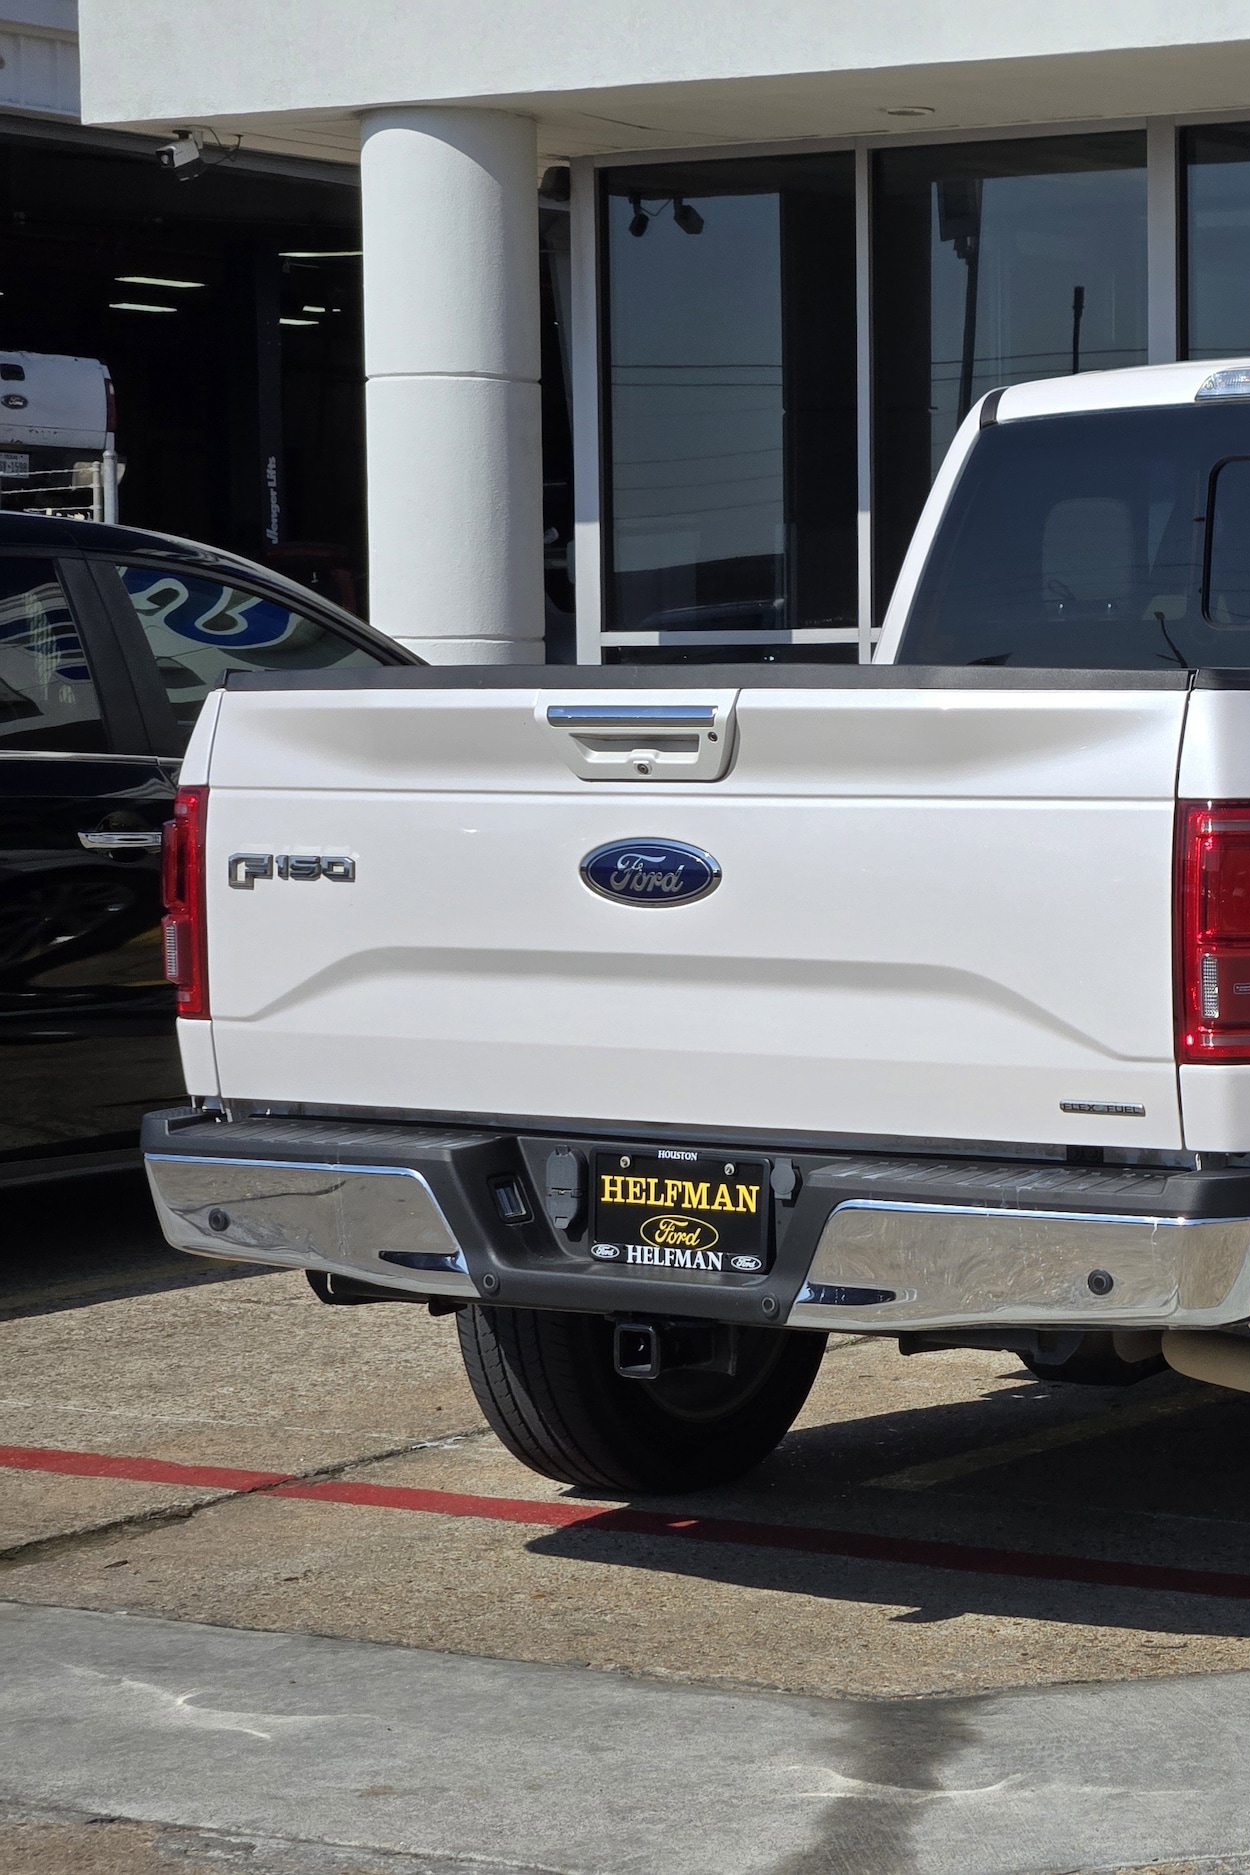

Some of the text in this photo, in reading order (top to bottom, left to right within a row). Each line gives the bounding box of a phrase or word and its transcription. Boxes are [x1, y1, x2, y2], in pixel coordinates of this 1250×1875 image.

[609, 852, 684, 894] Ford
[1062, 1102, 1140, 1114] FLEX FUEL
[658, 1149, 698, 1161] HOUSTON
[600, 1174, 760, 1213] HELFMAN
[654, 1217, 702, 1246] Ford
[625, 1244, 724, 1272] HELFMAN
